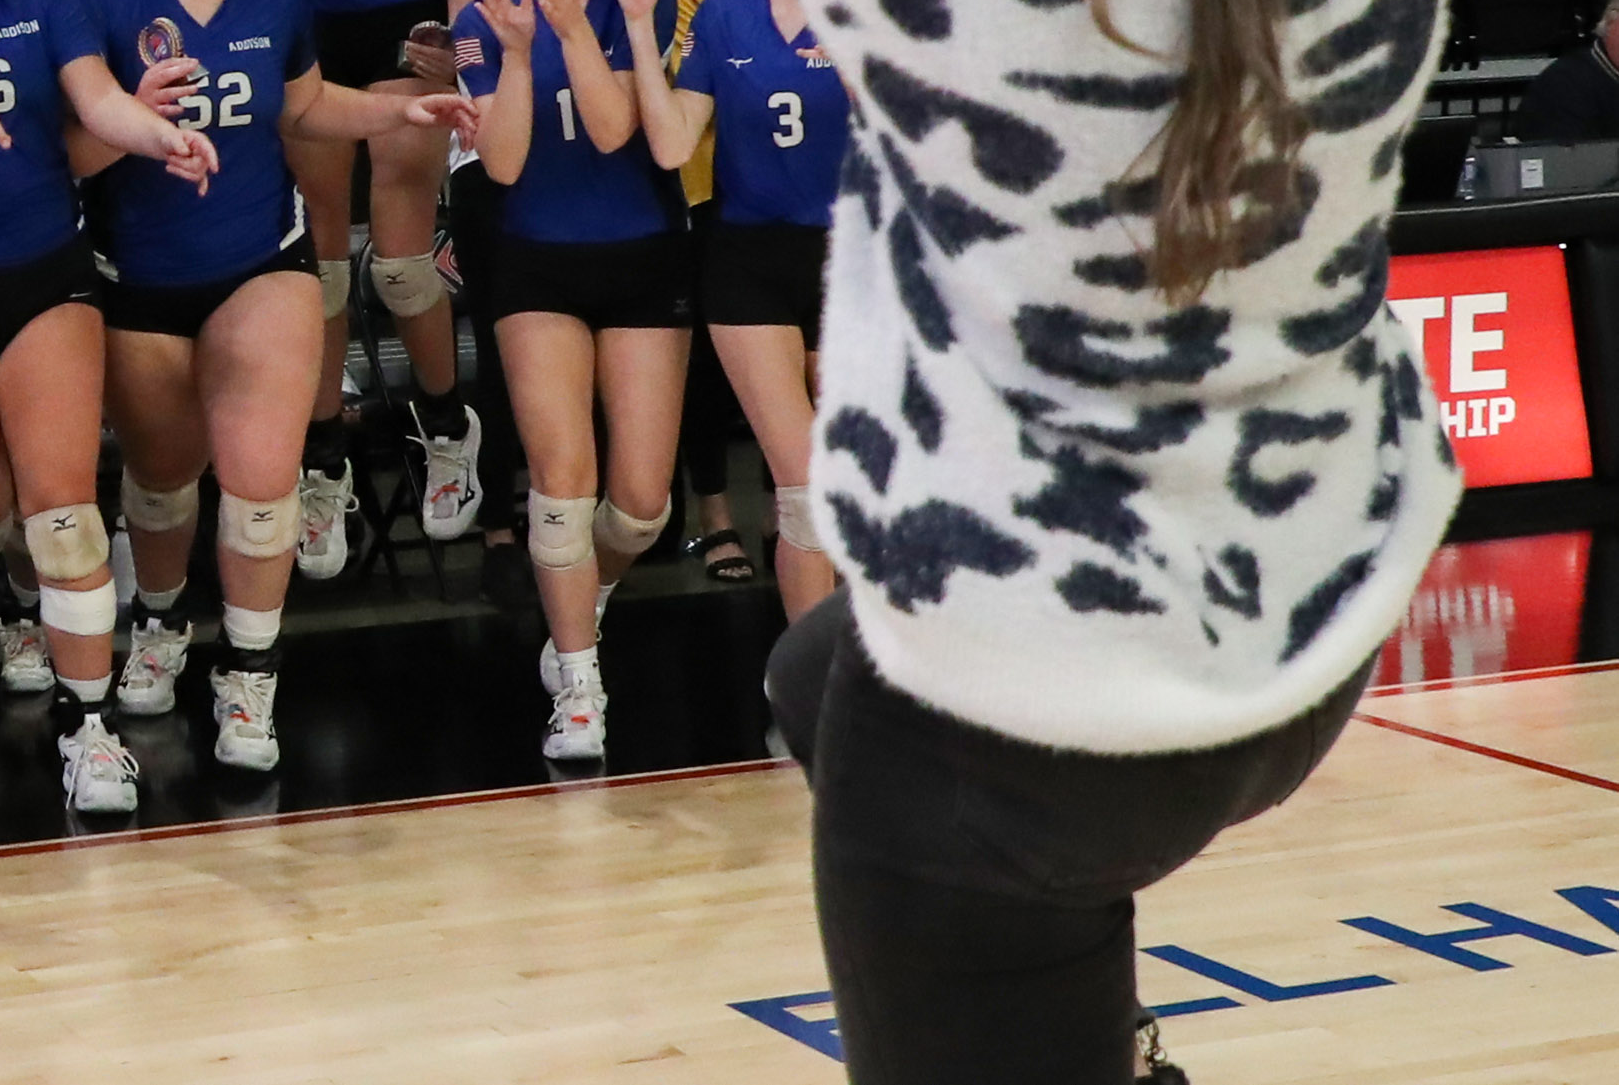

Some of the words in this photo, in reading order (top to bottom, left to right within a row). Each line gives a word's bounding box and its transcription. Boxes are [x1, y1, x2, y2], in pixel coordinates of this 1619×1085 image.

[228, 36, 271, 52] ADDISON
[177, 72, 253, 131] 52
[556, 88, 576, 141] 1
[767, 92, 804, 148] 3
